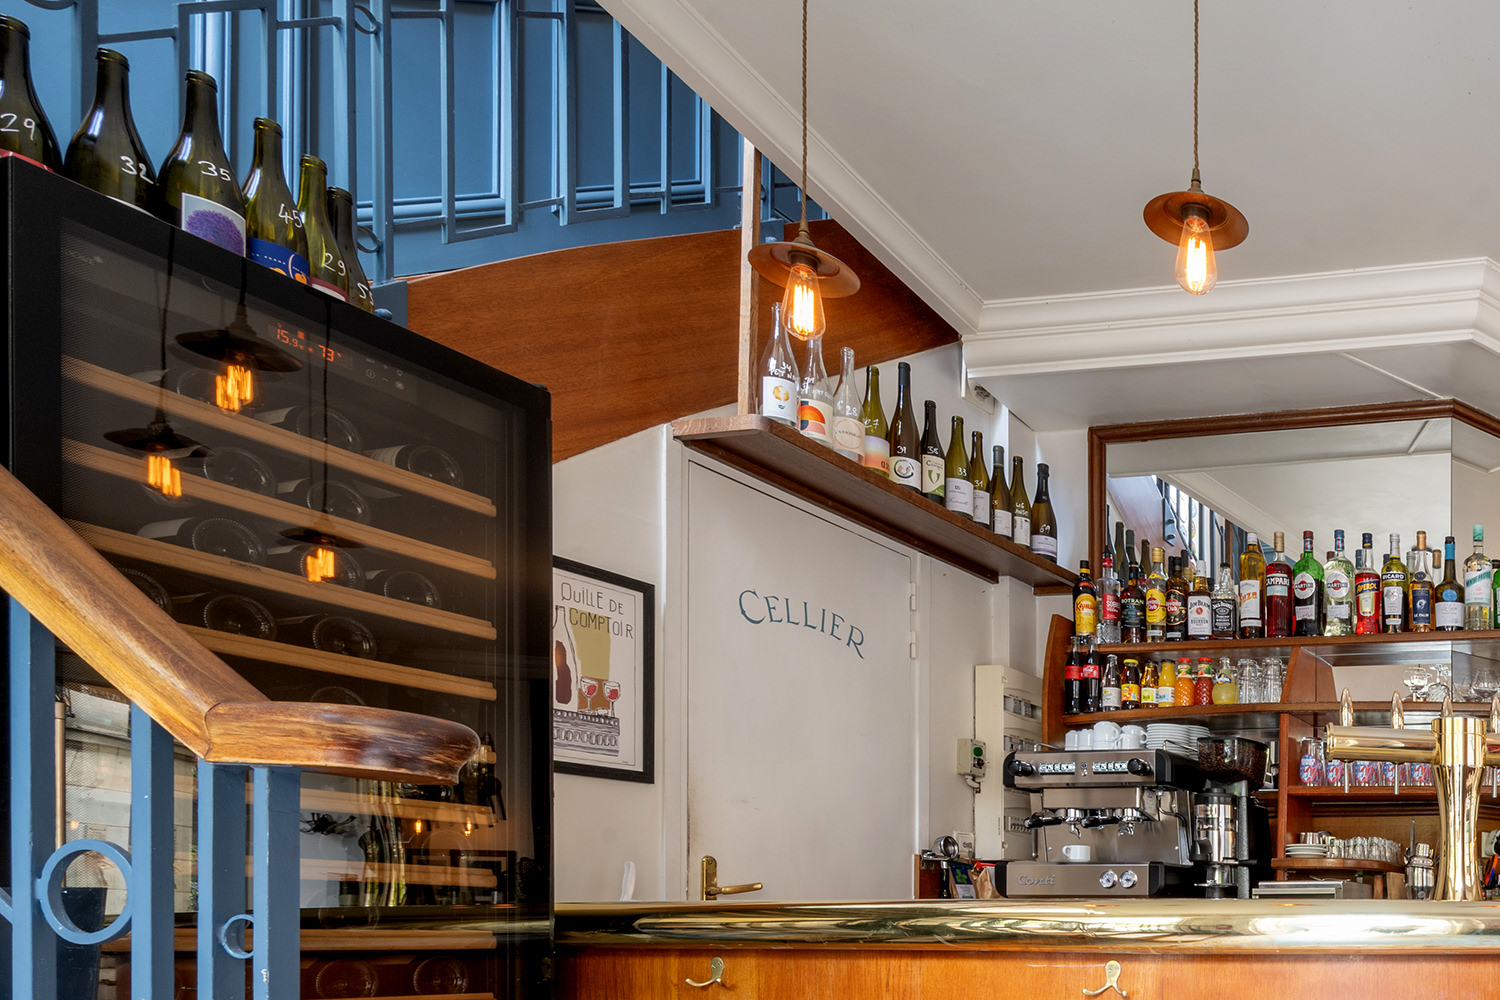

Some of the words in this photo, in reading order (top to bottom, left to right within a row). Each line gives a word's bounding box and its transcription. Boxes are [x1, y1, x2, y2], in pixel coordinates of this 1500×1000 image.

[0, 113, 35, 141] 29
[120, 155, 155, 185] 32
[198, 160, 231, 181] 35
[278, 203, 304, 228] 45
[323, 252, 346, 276] 29
[609, 599, 624, 615] DE
[738, 588, 865, 660] CELLIER
[1017, 874, 1056, 886] Conti
